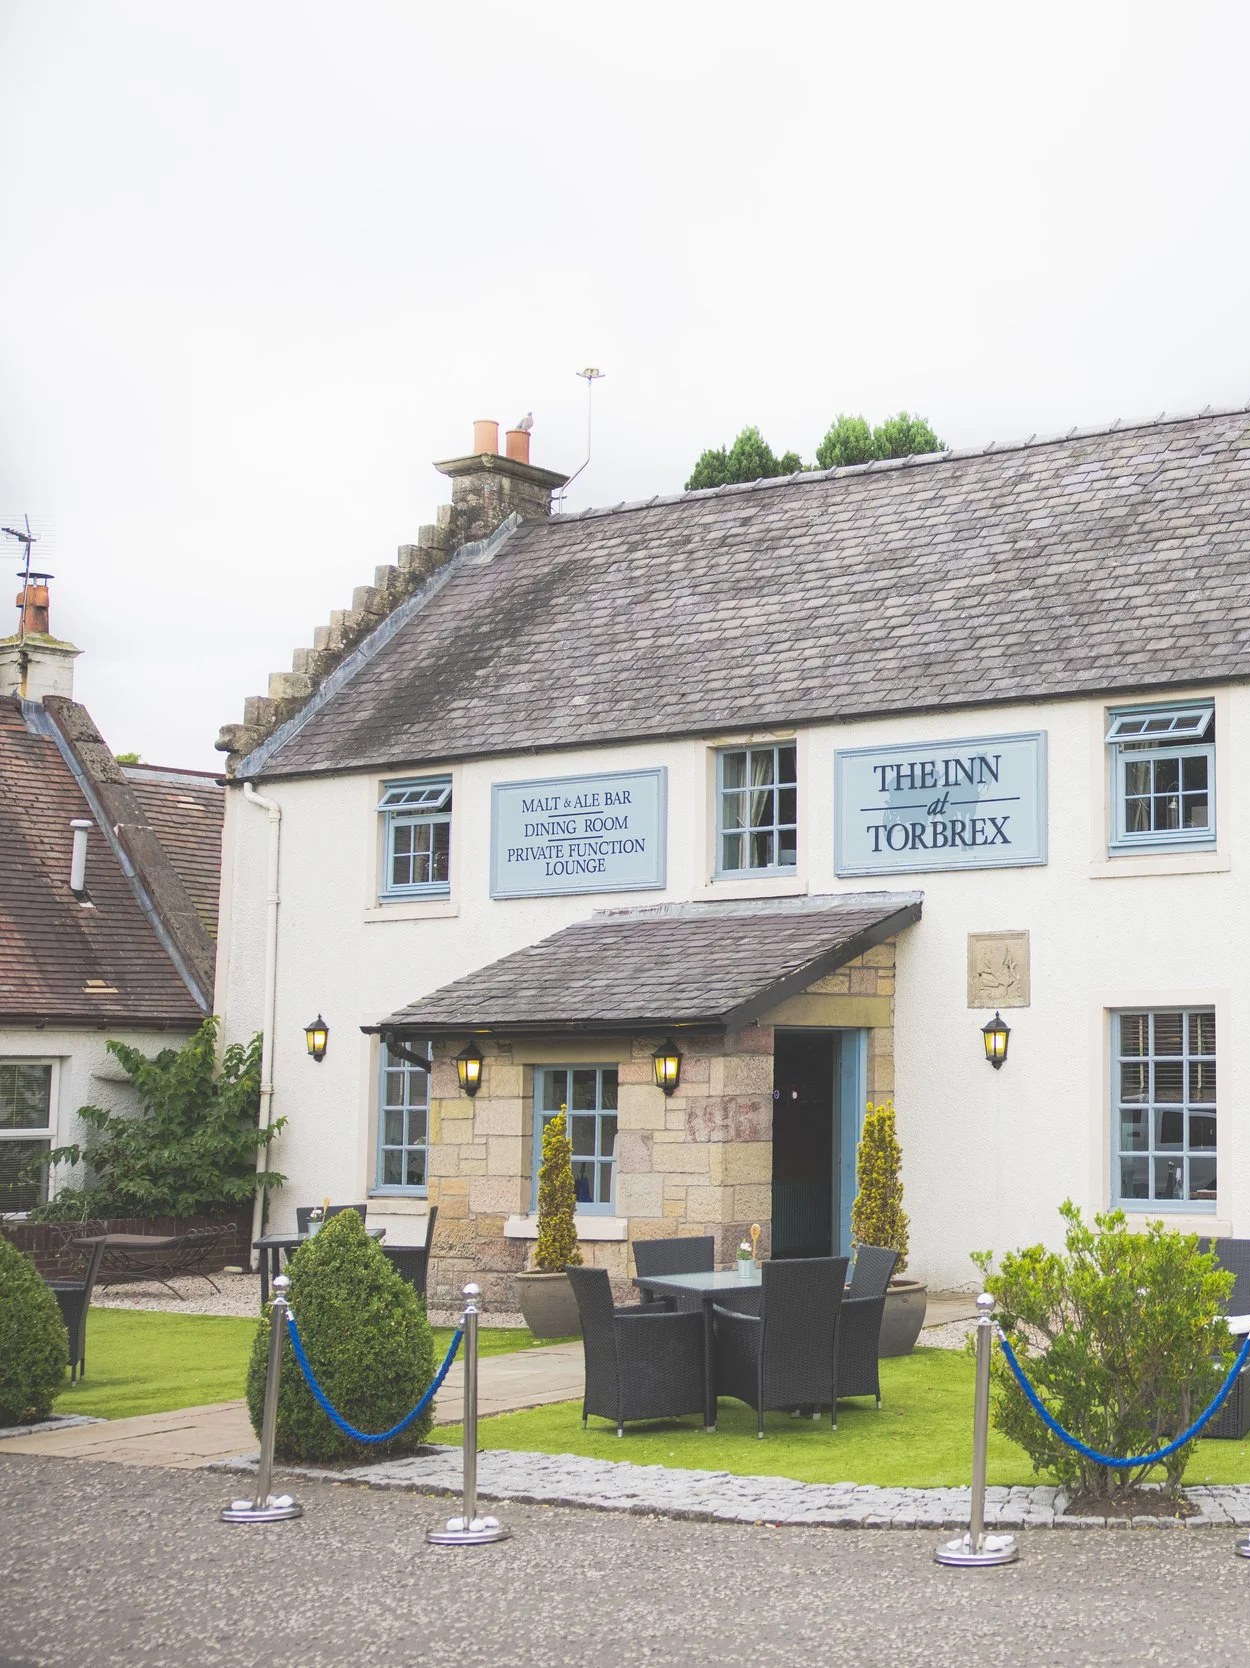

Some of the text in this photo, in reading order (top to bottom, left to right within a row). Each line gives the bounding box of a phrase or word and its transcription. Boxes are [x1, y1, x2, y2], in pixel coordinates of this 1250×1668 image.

[873, 754, 1002, 792] THE INN
[521, 790, 632, 813] MALT & ALE BAR
[926, 791, 950, 816] at
[524, 815, 629, 838] DINING ROOM
[866, 815, 1012, 852] TORBREX
[507, 838, 646, 862] PRIVATE FUNCTION
[545, 858, 607, 876] LOUNGE
